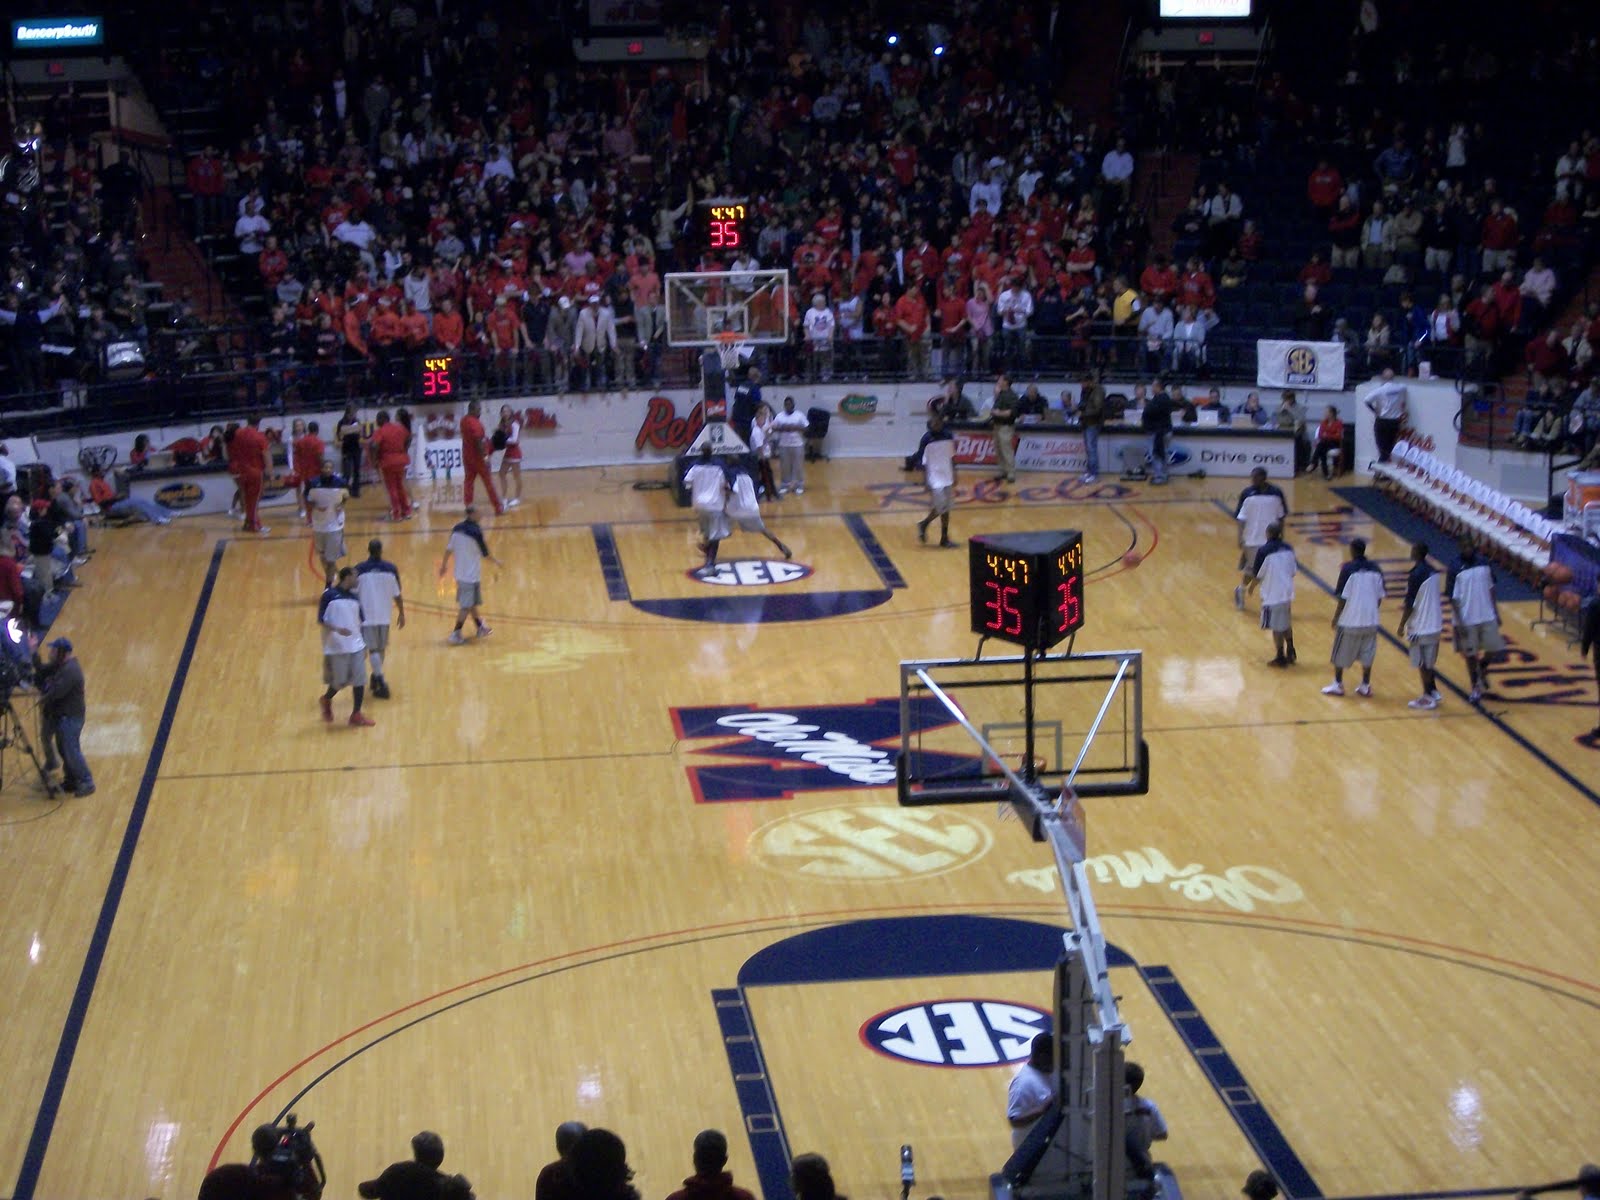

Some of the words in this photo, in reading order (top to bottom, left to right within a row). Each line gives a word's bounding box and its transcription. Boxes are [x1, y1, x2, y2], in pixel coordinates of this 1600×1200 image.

[711, 205, 745, 220] 4:47
[710, 221, 738, 246] 35
[423, 371, 452, 395] 35
[1200, 450, 1248, 464] Drive
[986, 554, 1029, 585] 4:47
[985, 581, 1022, 635] 35
[1057, 576, 1080, 633] 35
